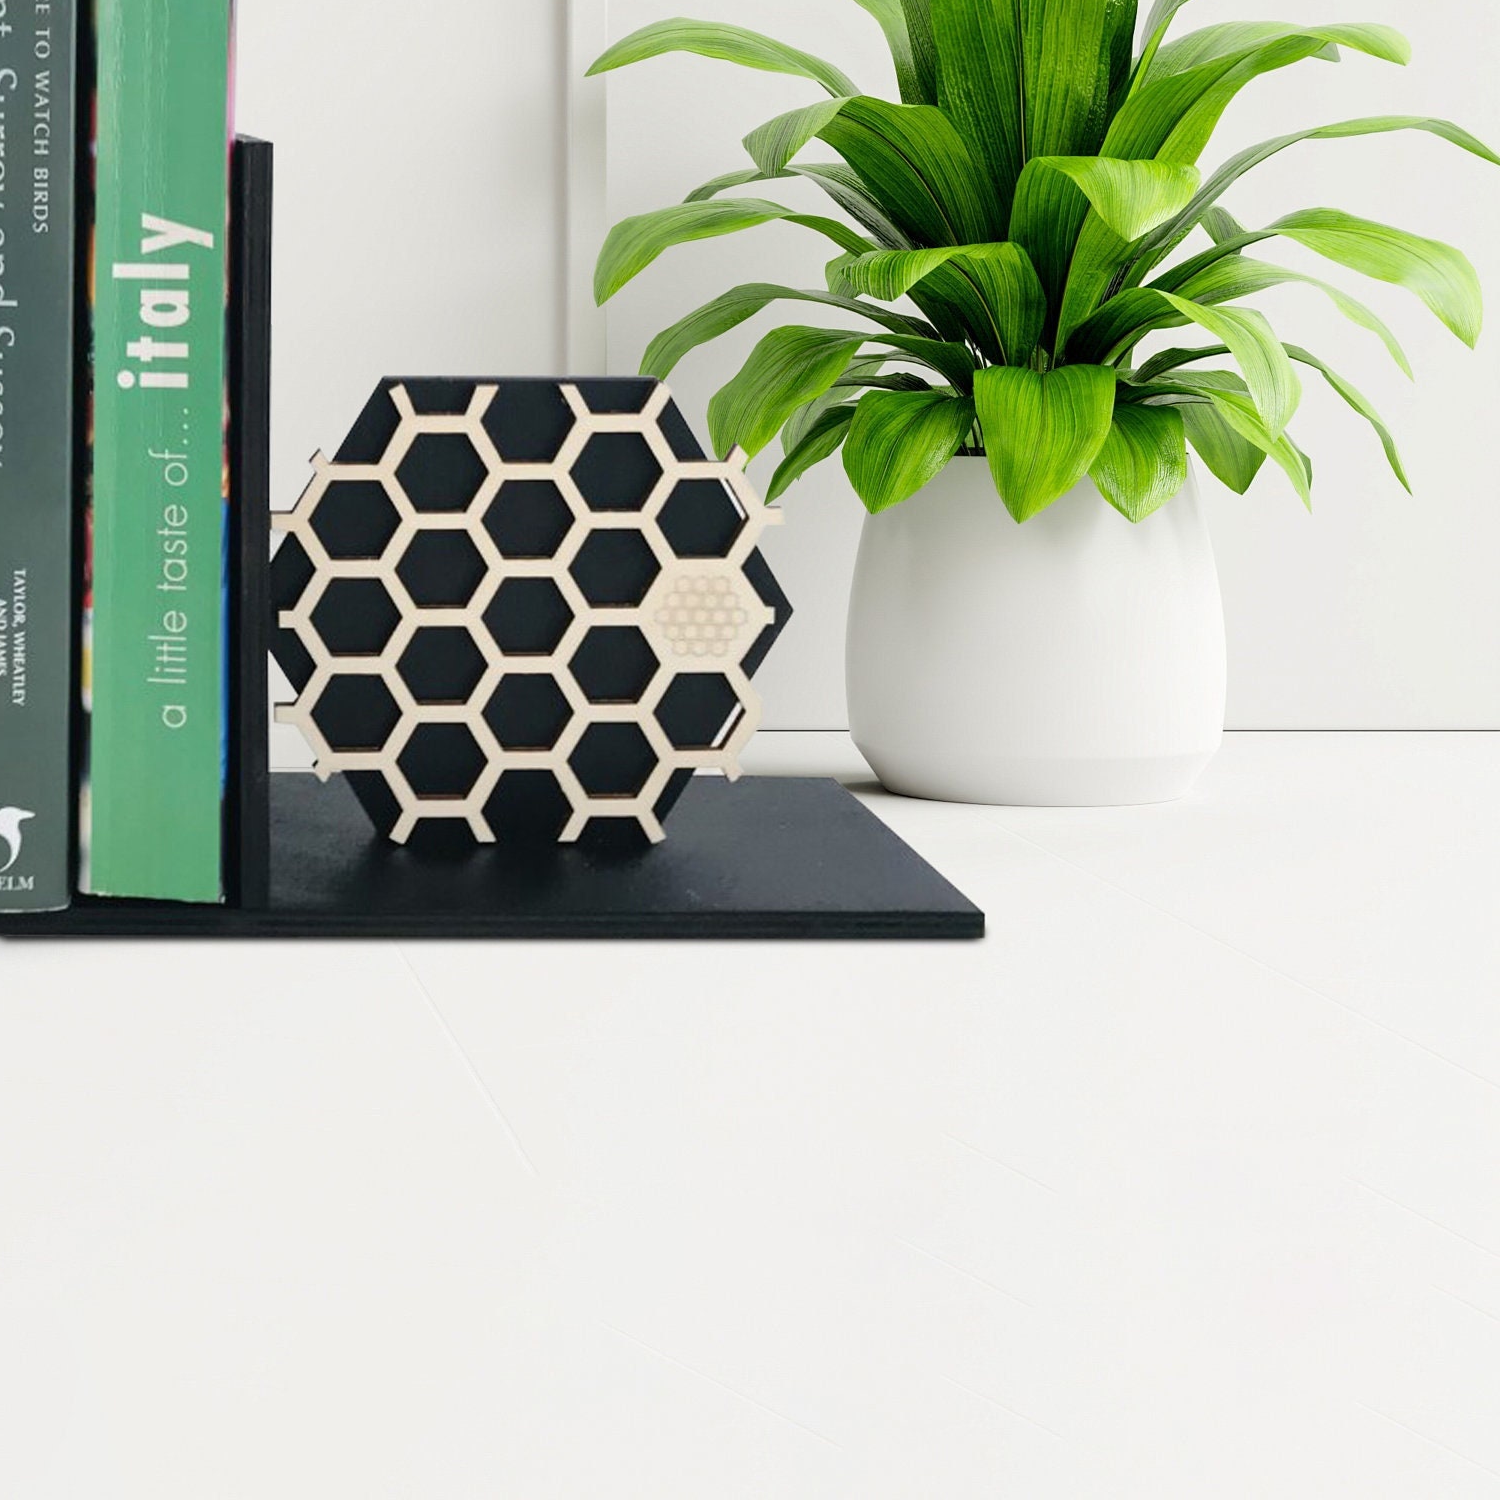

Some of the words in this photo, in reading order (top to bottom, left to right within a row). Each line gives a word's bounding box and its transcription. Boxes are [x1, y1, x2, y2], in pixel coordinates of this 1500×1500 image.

[35, 29, 51, 59] TO
[33, 70, 50, 155] WATCH
[32, 167, 49, 233] BIRDS
[111, 212, 214, 389] italy
[156, 504, 188, 591] taste
[11, 569, 26, 628] TAYLOR,
[12, 631, 25, 705] WHEATLEY
[146, 610, 188, 684] little
[162, 704, 187, 729] a
